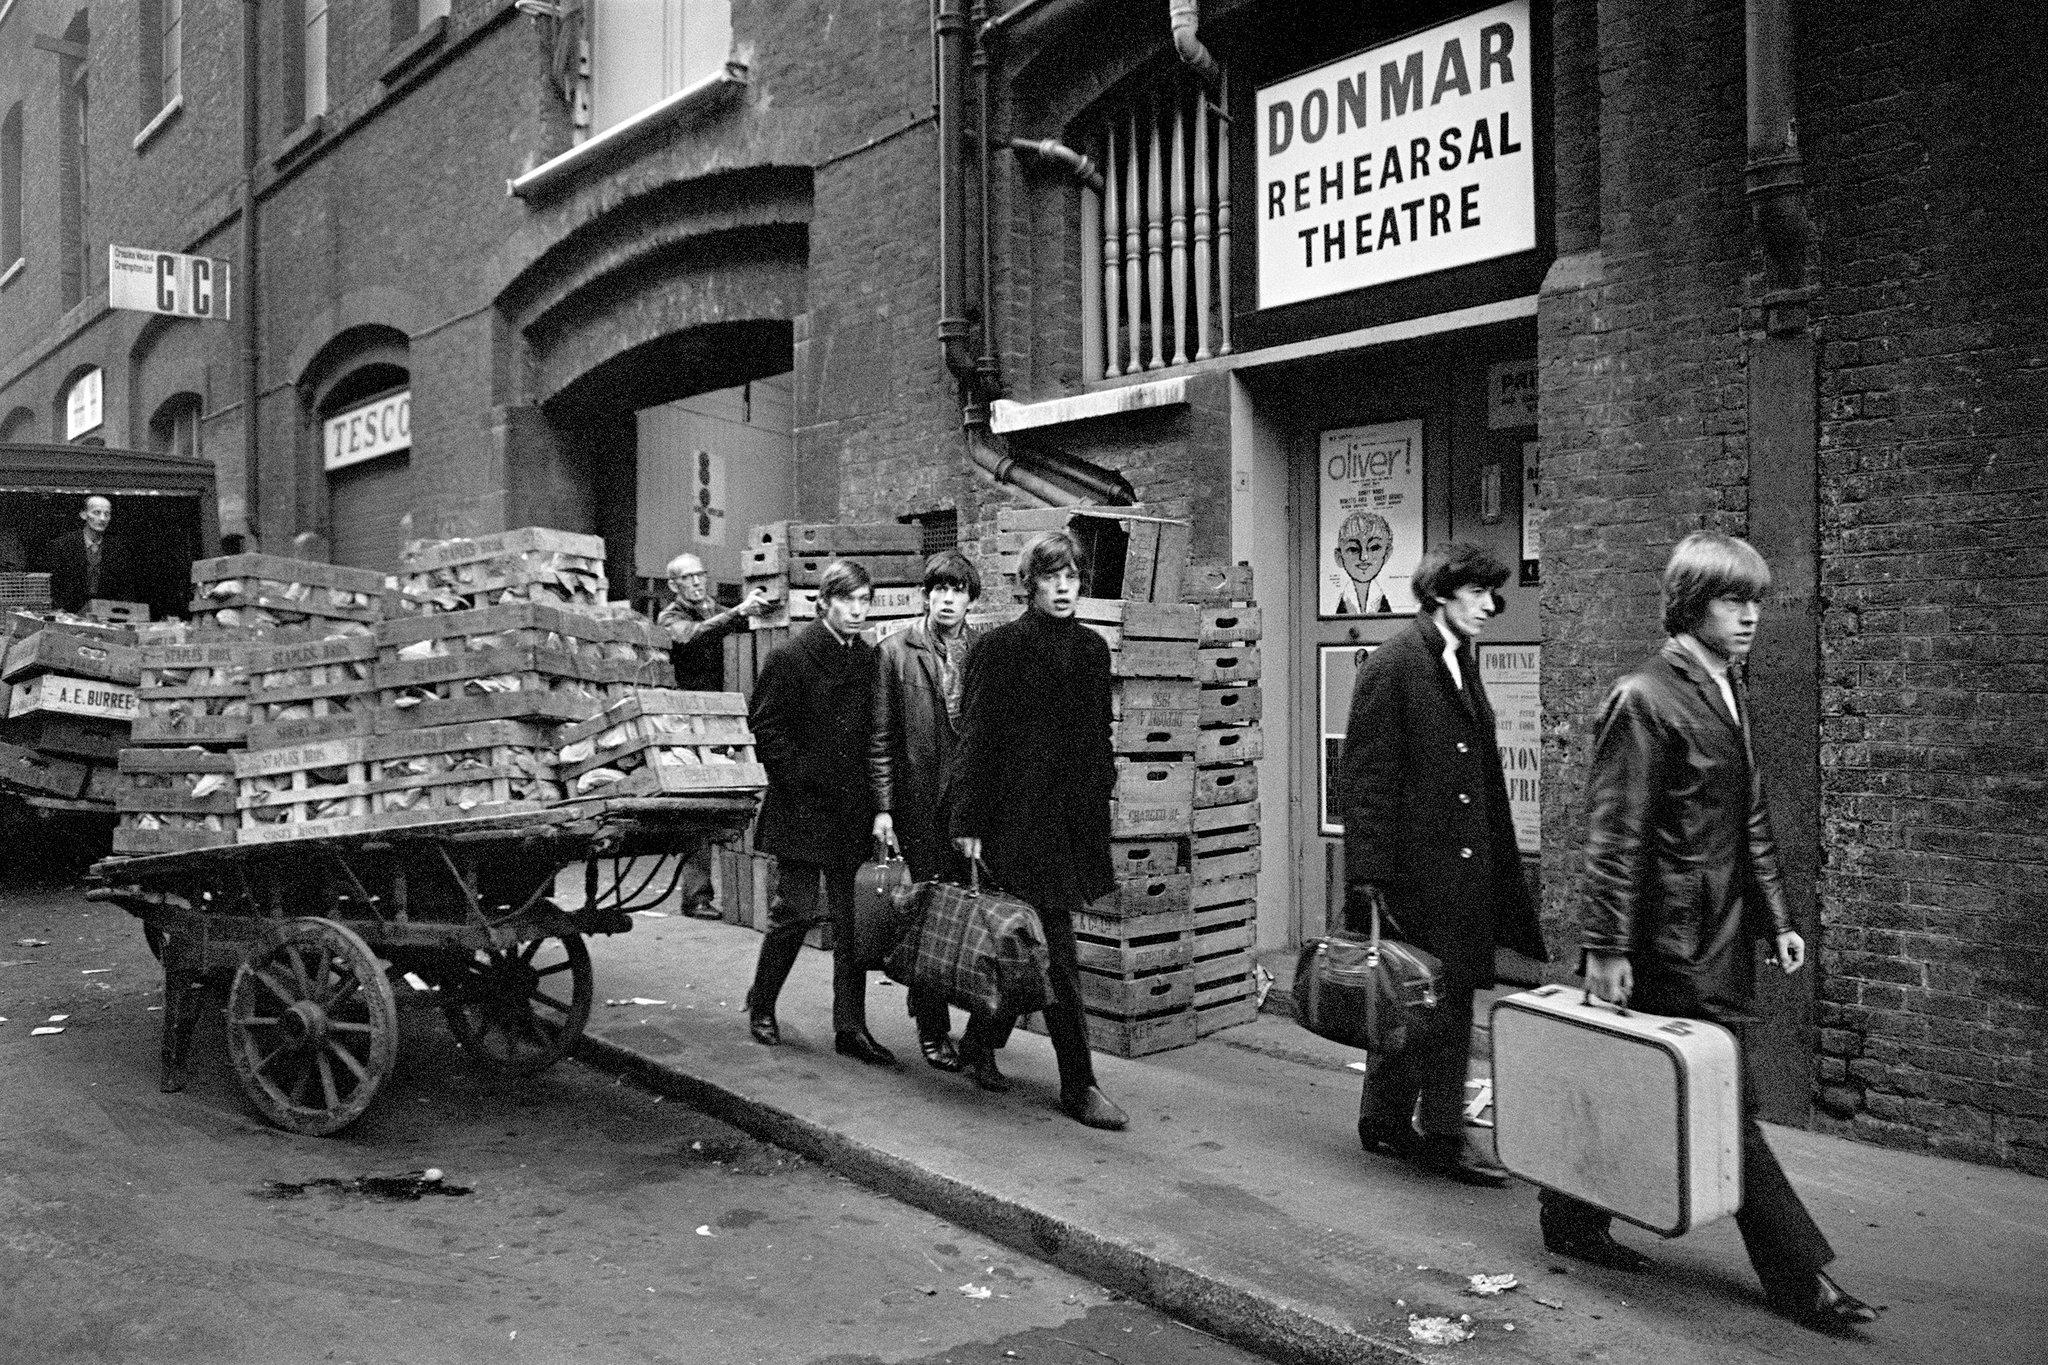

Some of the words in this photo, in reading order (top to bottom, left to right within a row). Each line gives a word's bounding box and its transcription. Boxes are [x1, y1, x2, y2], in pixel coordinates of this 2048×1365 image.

[1268, 21, 1515, 157] DONMAR
[1268, 111, 1522, 220] REHEARSAL
[1298, 183, 1481, 268] THEATRE
[334, 400, 410, 457] TESCO
[1328, 437, 1412, 481] oliver!
[1485, 653, 1536, 670] FORTUNE
